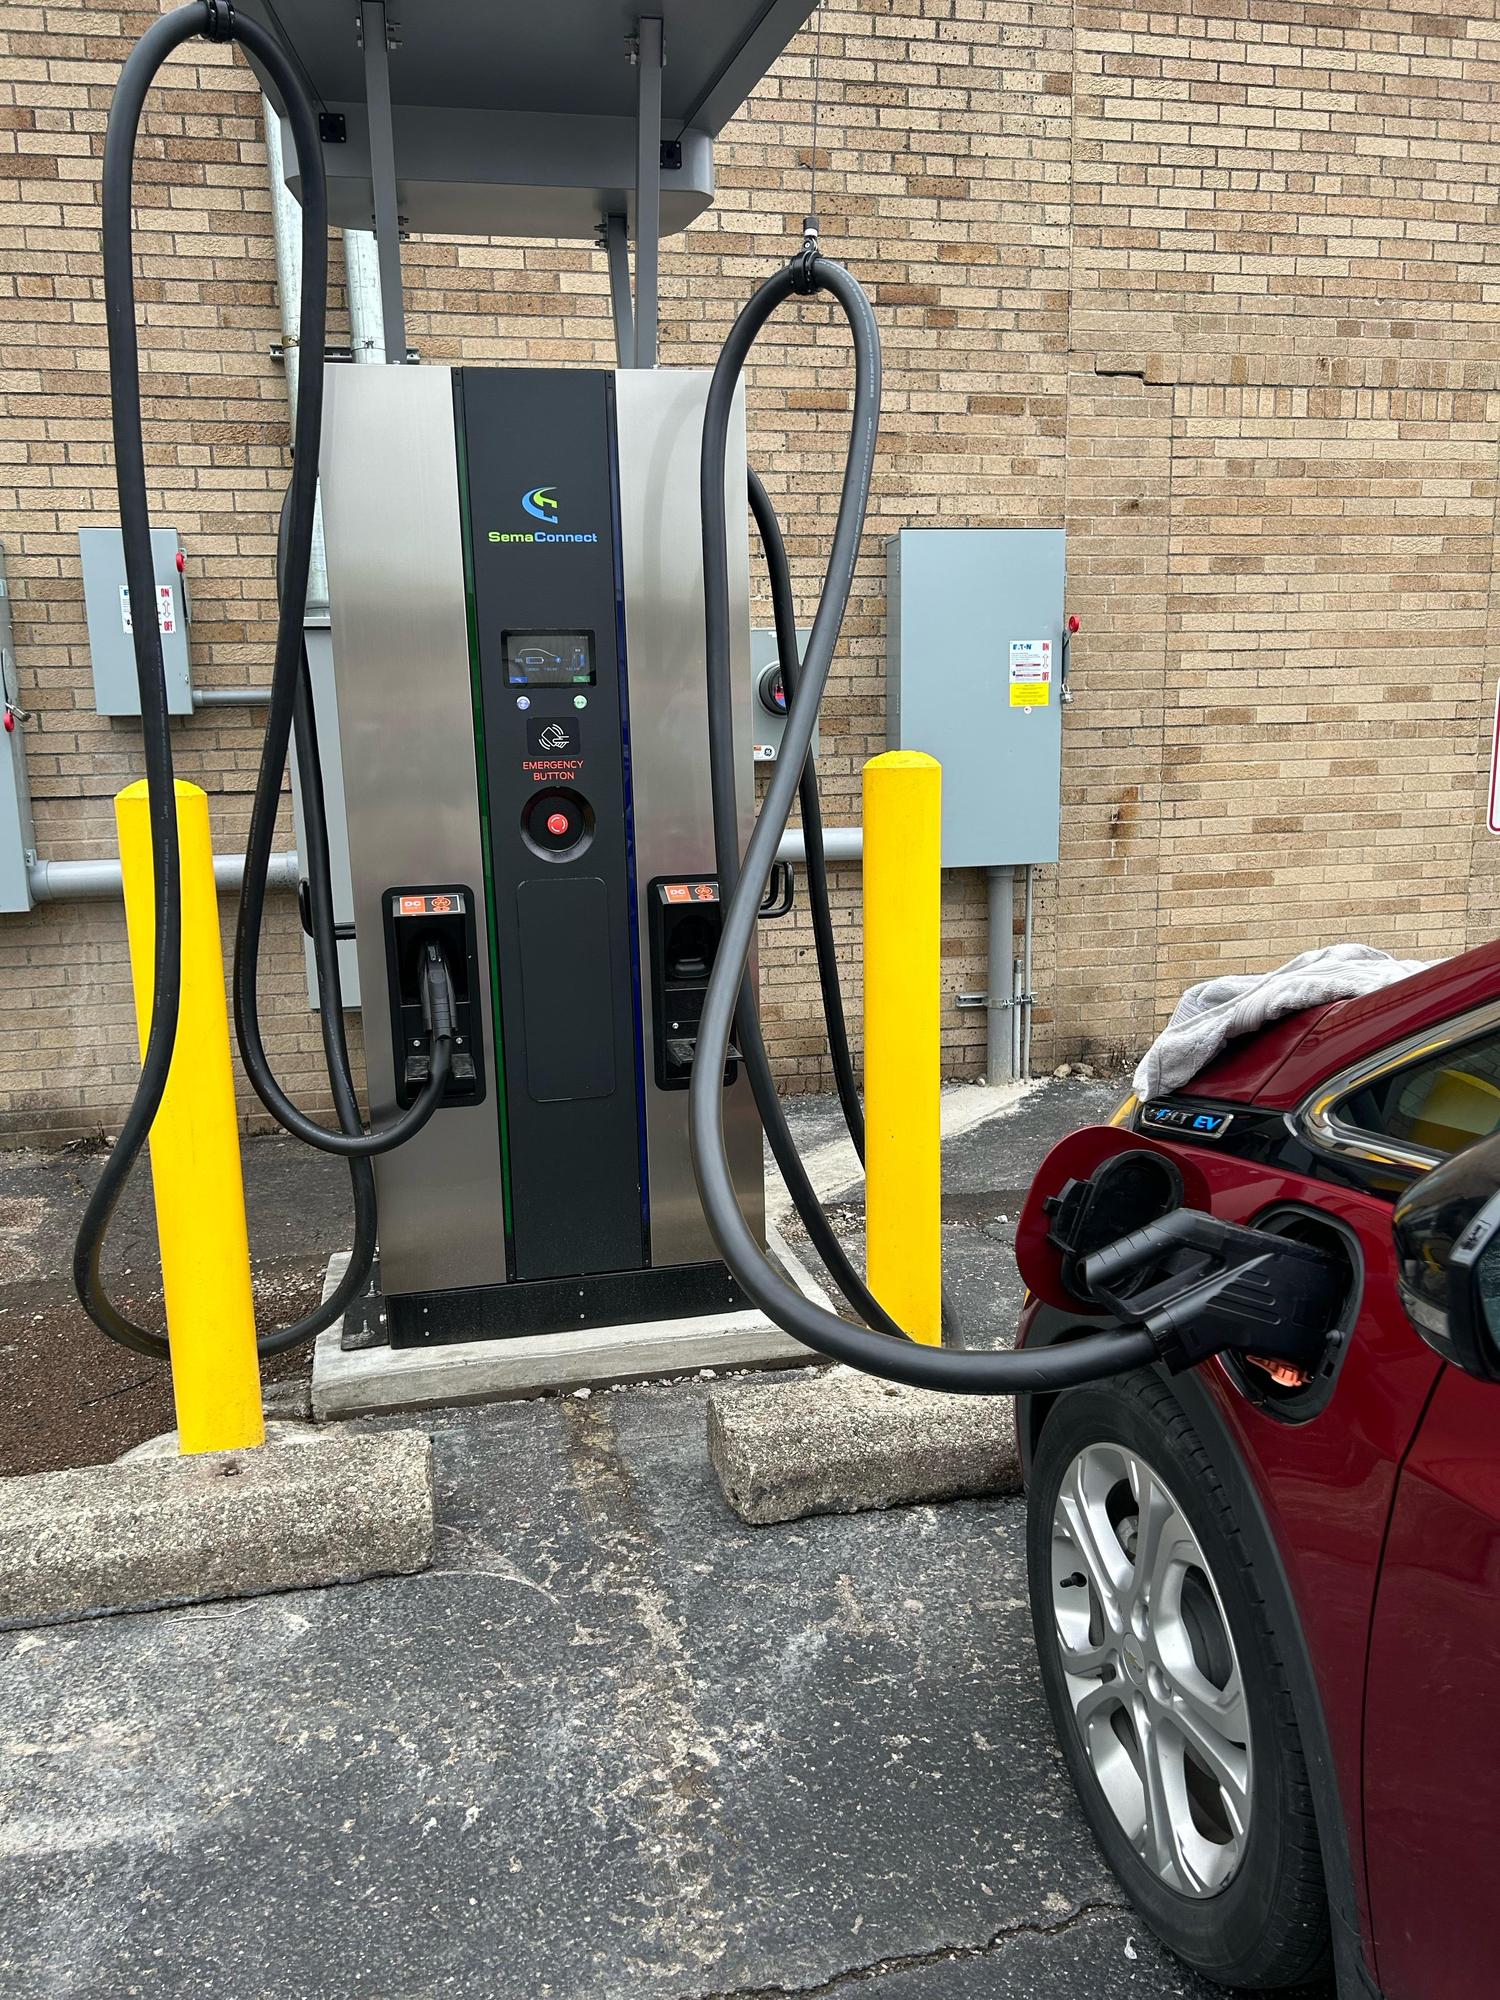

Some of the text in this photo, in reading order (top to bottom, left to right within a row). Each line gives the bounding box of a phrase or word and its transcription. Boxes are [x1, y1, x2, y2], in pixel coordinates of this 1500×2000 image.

[488, 531, 598, 543] SemaConnect
[160, 587, 170, 598] ON
[164, 620, 173, 631] OFF
[1042, 642, 1050, 651] ON
[1042, 671, 1050, 681] OFF
[522, 760, 584, 770] EMERGENCY
[533, 771, 575, 781] BUTTON
[1193, 1115, 1223, 1131] EV
